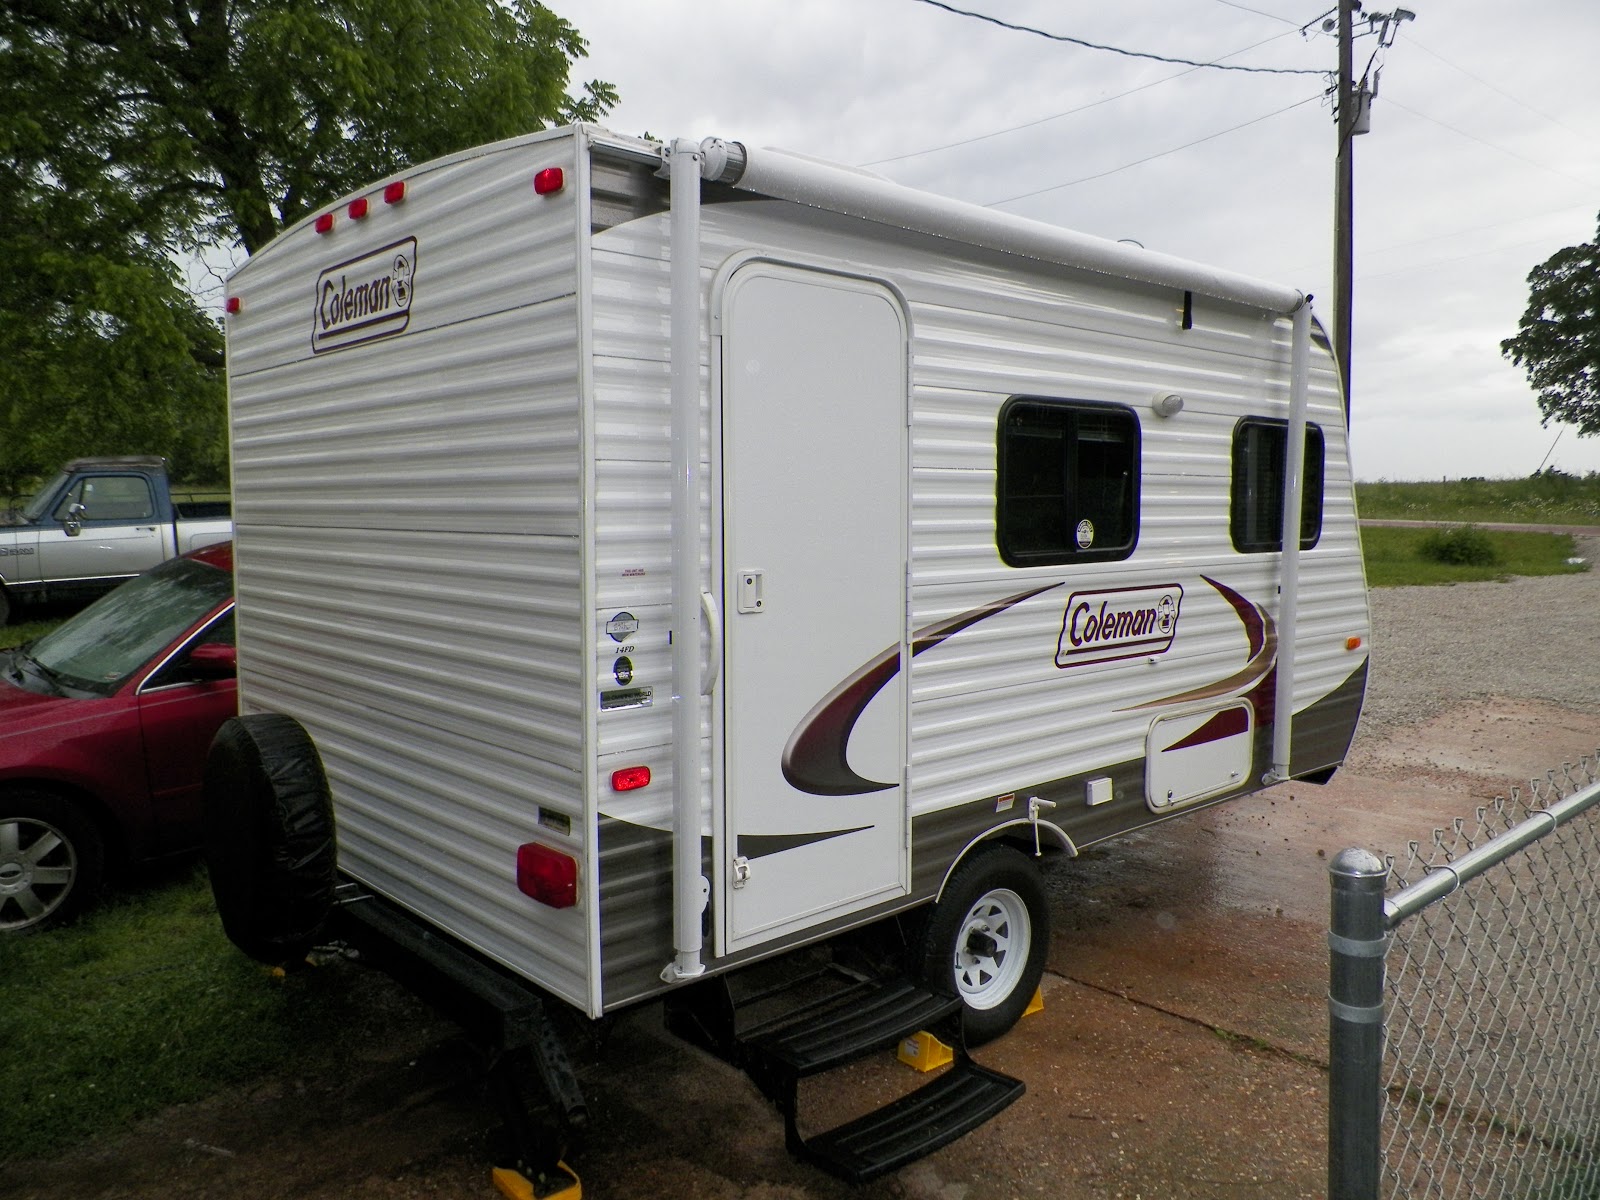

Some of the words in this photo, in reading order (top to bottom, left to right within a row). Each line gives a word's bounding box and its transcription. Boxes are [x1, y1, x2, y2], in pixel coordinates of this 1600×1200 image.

[320, 275, 391, 330] Coleman
[1069, 600, 1157, 647] Coleman
[615, 645, 635, 654] 14FD
